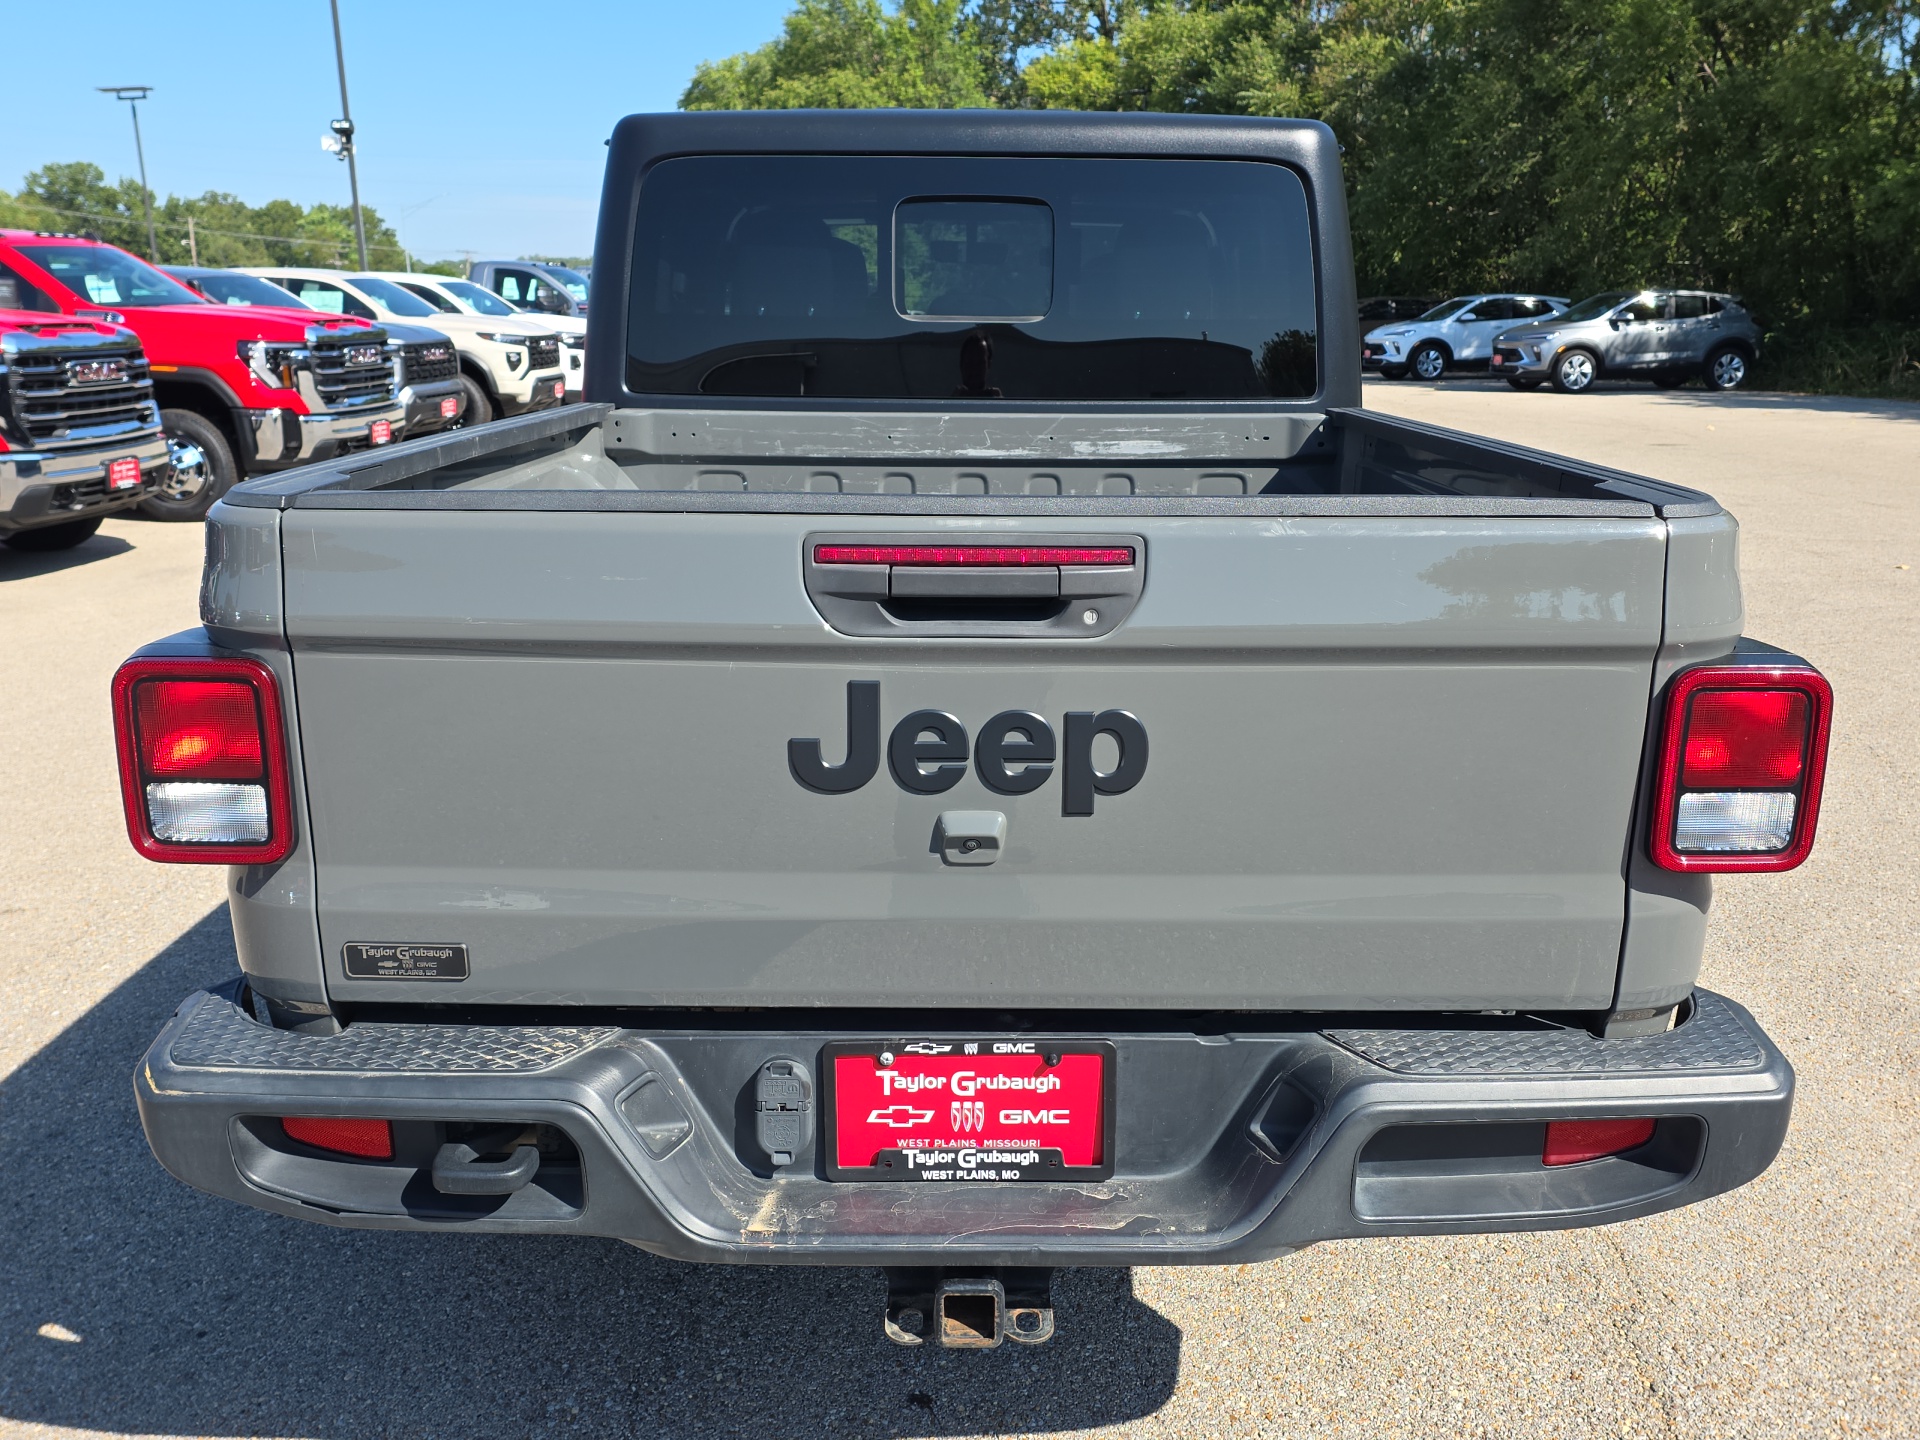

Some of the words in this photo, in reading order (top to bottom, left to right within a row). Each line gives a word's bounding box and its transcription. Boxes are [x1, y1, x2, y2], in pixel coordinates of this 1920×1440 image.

[787, 680, 1149, 817] Jeep
[357, 946, 395, 959] Taylor
[396, 946, 453, 960] Grubaugh
[993, 1043, 1036, 1053] GMC
[875, 1071, 947, 1096] Taylor
[950, 1071, 1061, 1097] Grubaugh
[999, 1109, 1070, 1124] GMC
[896, 1139, 931, 1148] WEST
[984, 1139, 1041, 1148] MISSOURI
[902, 1149, 956, 1169] Taylor
[957, 1149, 1040, 1168] Grubaugh
[921, 1170, 954, 1180] WEST
[956, 1170, 999, 1181] PLAINS,
[1002, 1170, 1020, 1180] MO
